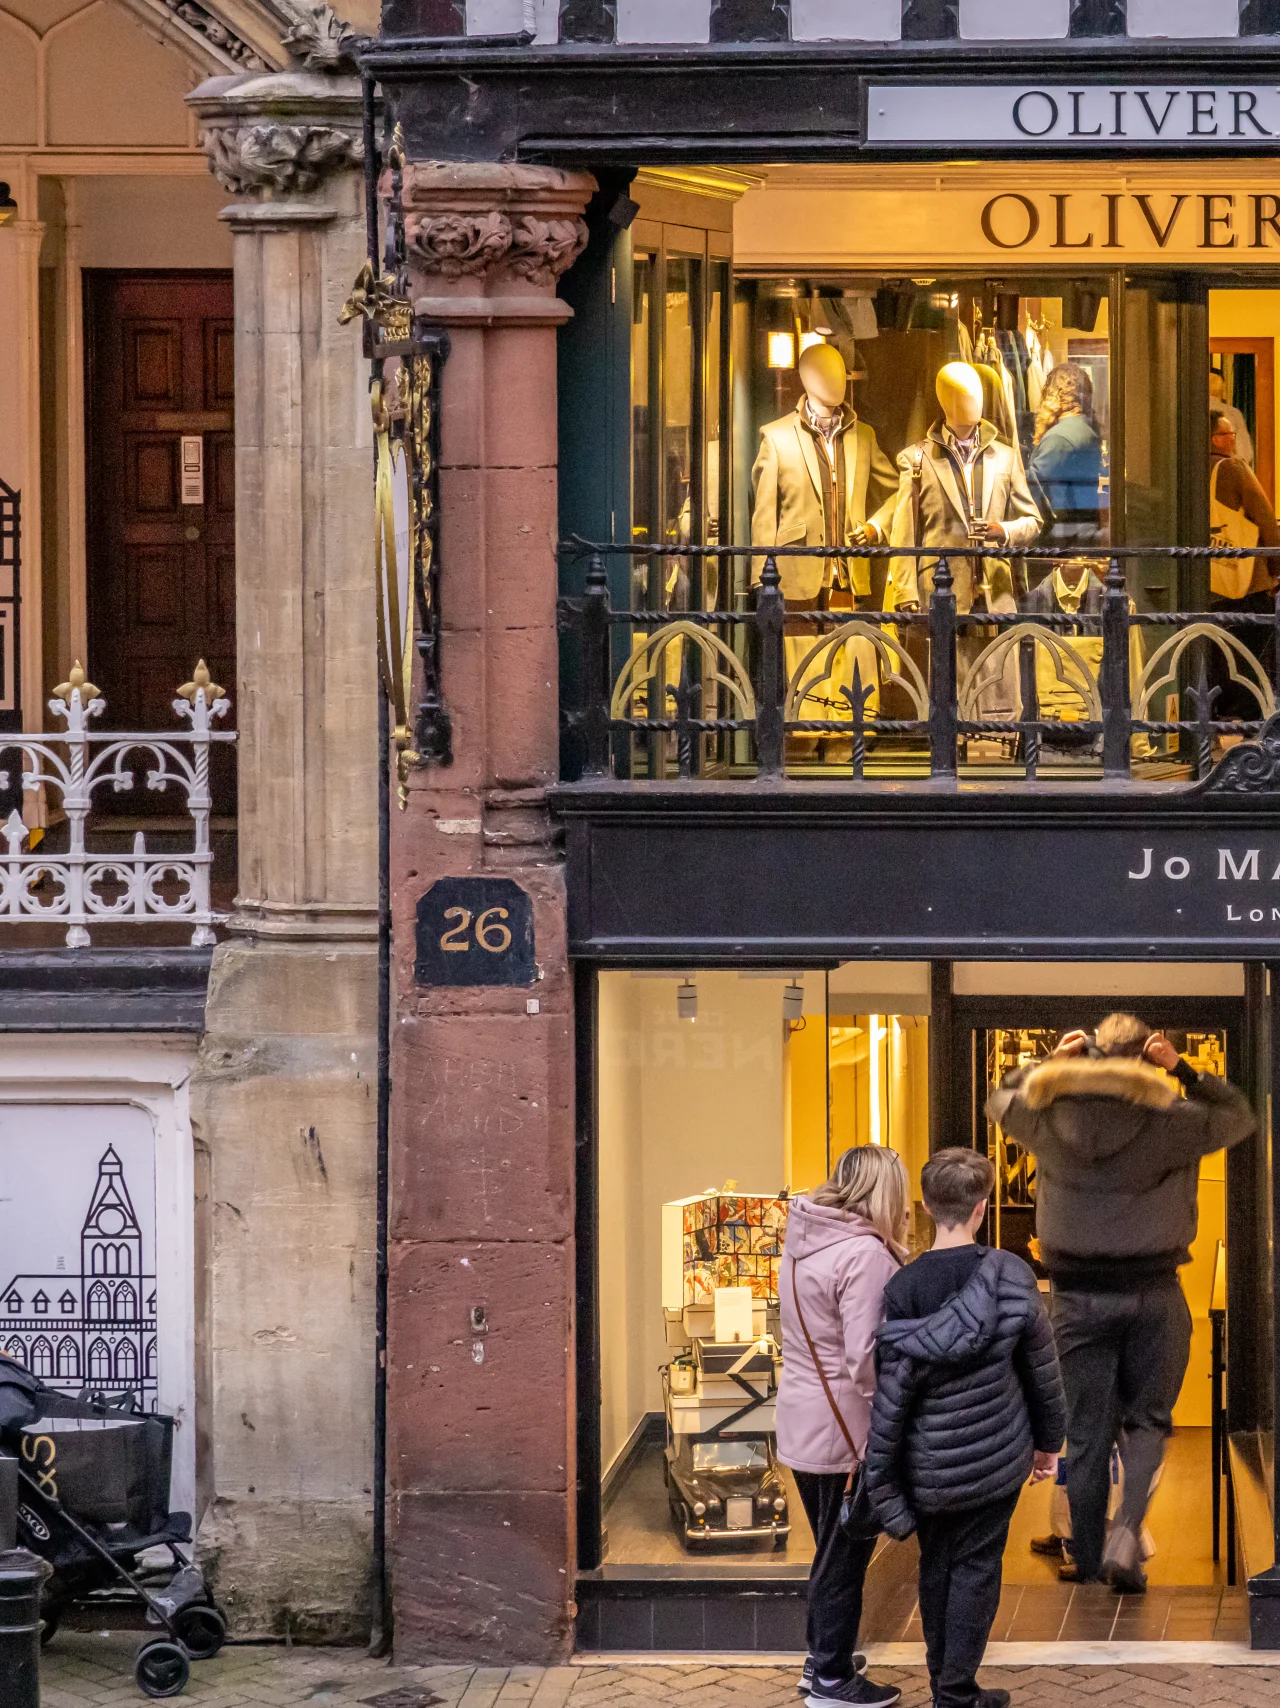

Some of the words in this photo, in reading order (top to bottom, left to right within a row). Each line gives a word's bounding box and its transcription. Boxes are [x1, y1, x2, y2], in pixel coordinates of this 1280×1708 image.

[1012, 90, 1273, 136] OLIVER
[1128, 848, 1191, 880] JO
[441, 906, 512, 953] 26
